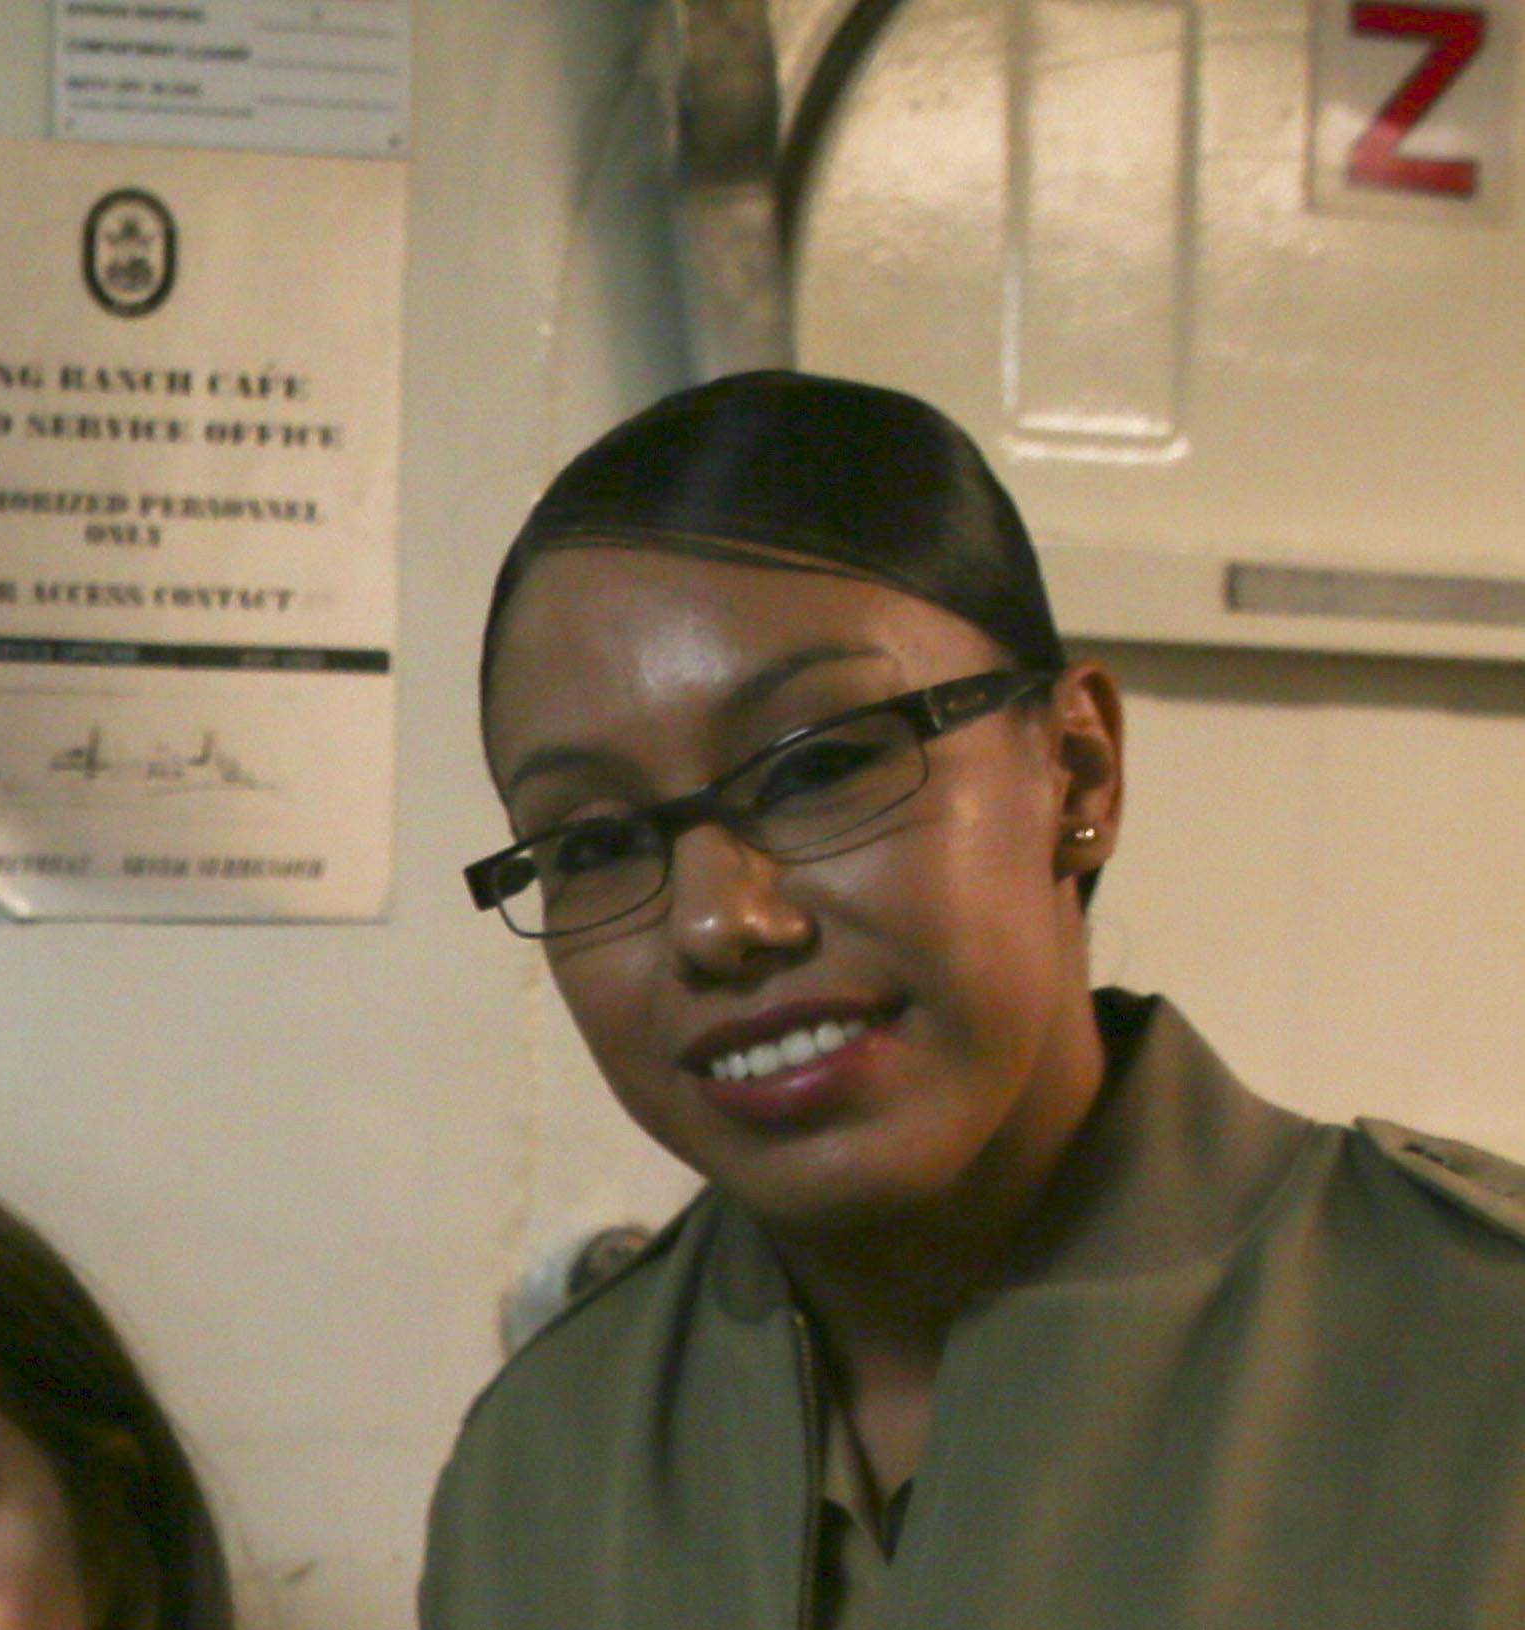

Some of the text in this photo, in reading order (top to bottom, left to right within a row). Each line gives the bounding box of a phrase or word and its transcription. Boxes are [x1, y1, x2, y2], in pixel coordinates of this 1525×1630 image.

[1348, 2, 1489, 201] Z
[59, 364, 192, 396] RANCH
[27, 411, 185, 443] SERVICE
[204, 419, 340, 449] OFFICE
[140, 493, 320, 522] PERSONNEL
[84, 522, 162, 549] ONLY
[34, 581, 144, 607] ACCESS
[153, 584, 294, 612] CONTACT
